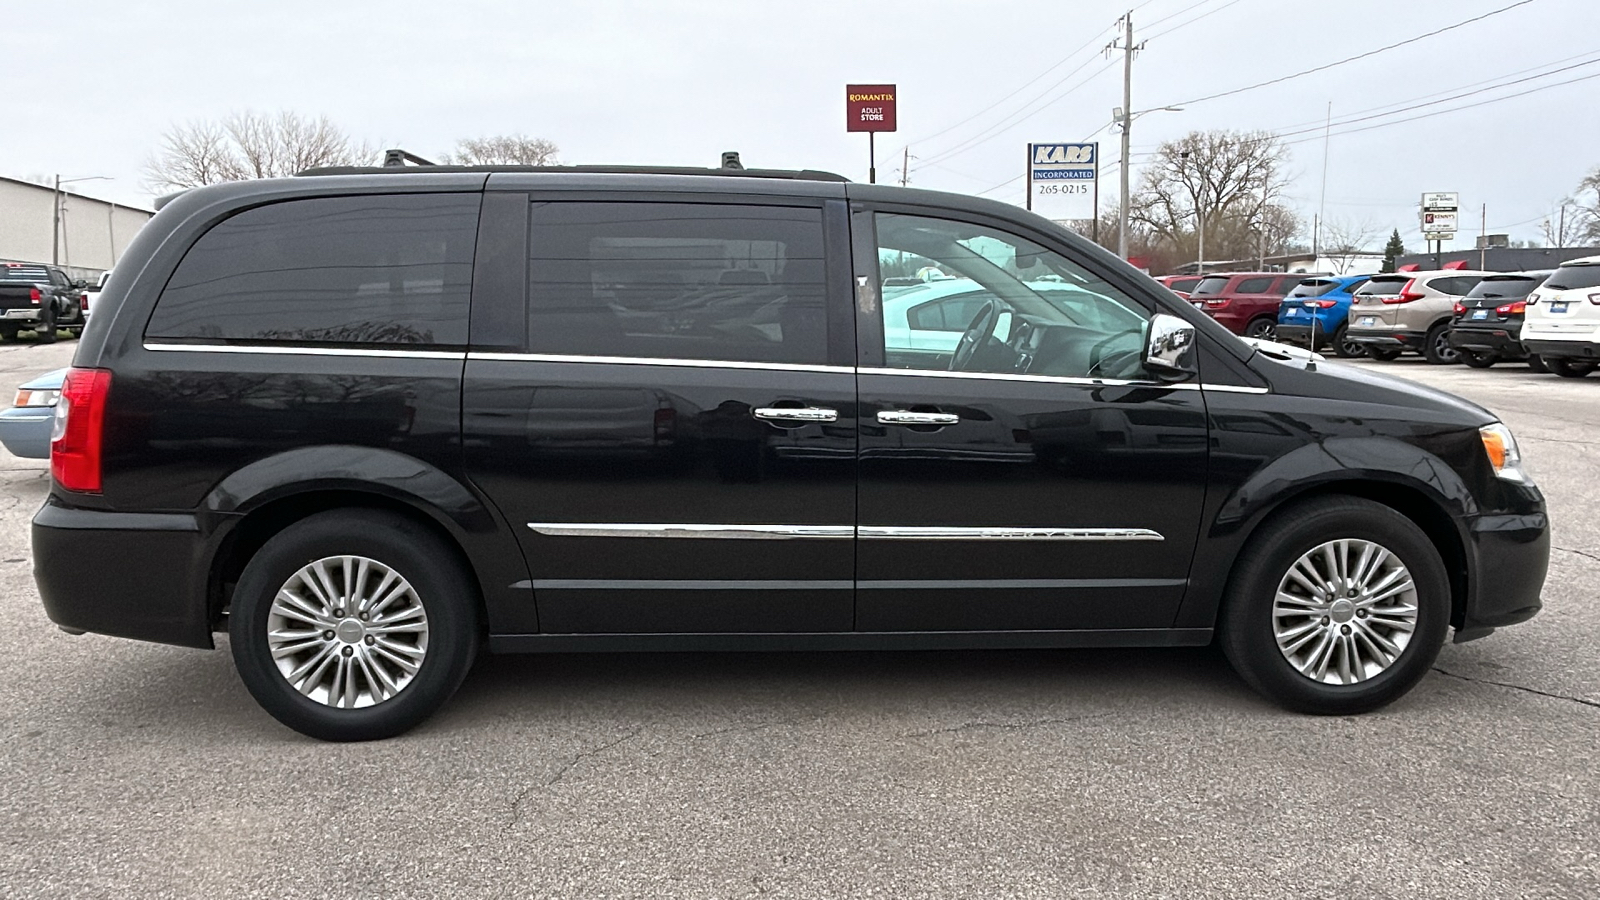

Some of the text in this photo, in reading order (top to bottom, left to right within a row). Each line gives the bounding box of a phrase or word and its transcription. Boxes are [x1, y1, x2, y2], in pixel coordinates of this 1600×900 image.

[850, 94, 894, 102] ROMANTIX
[1034, 146, 1093, 163] KARS
[1039, 184, 1088, 195] 265-0215
